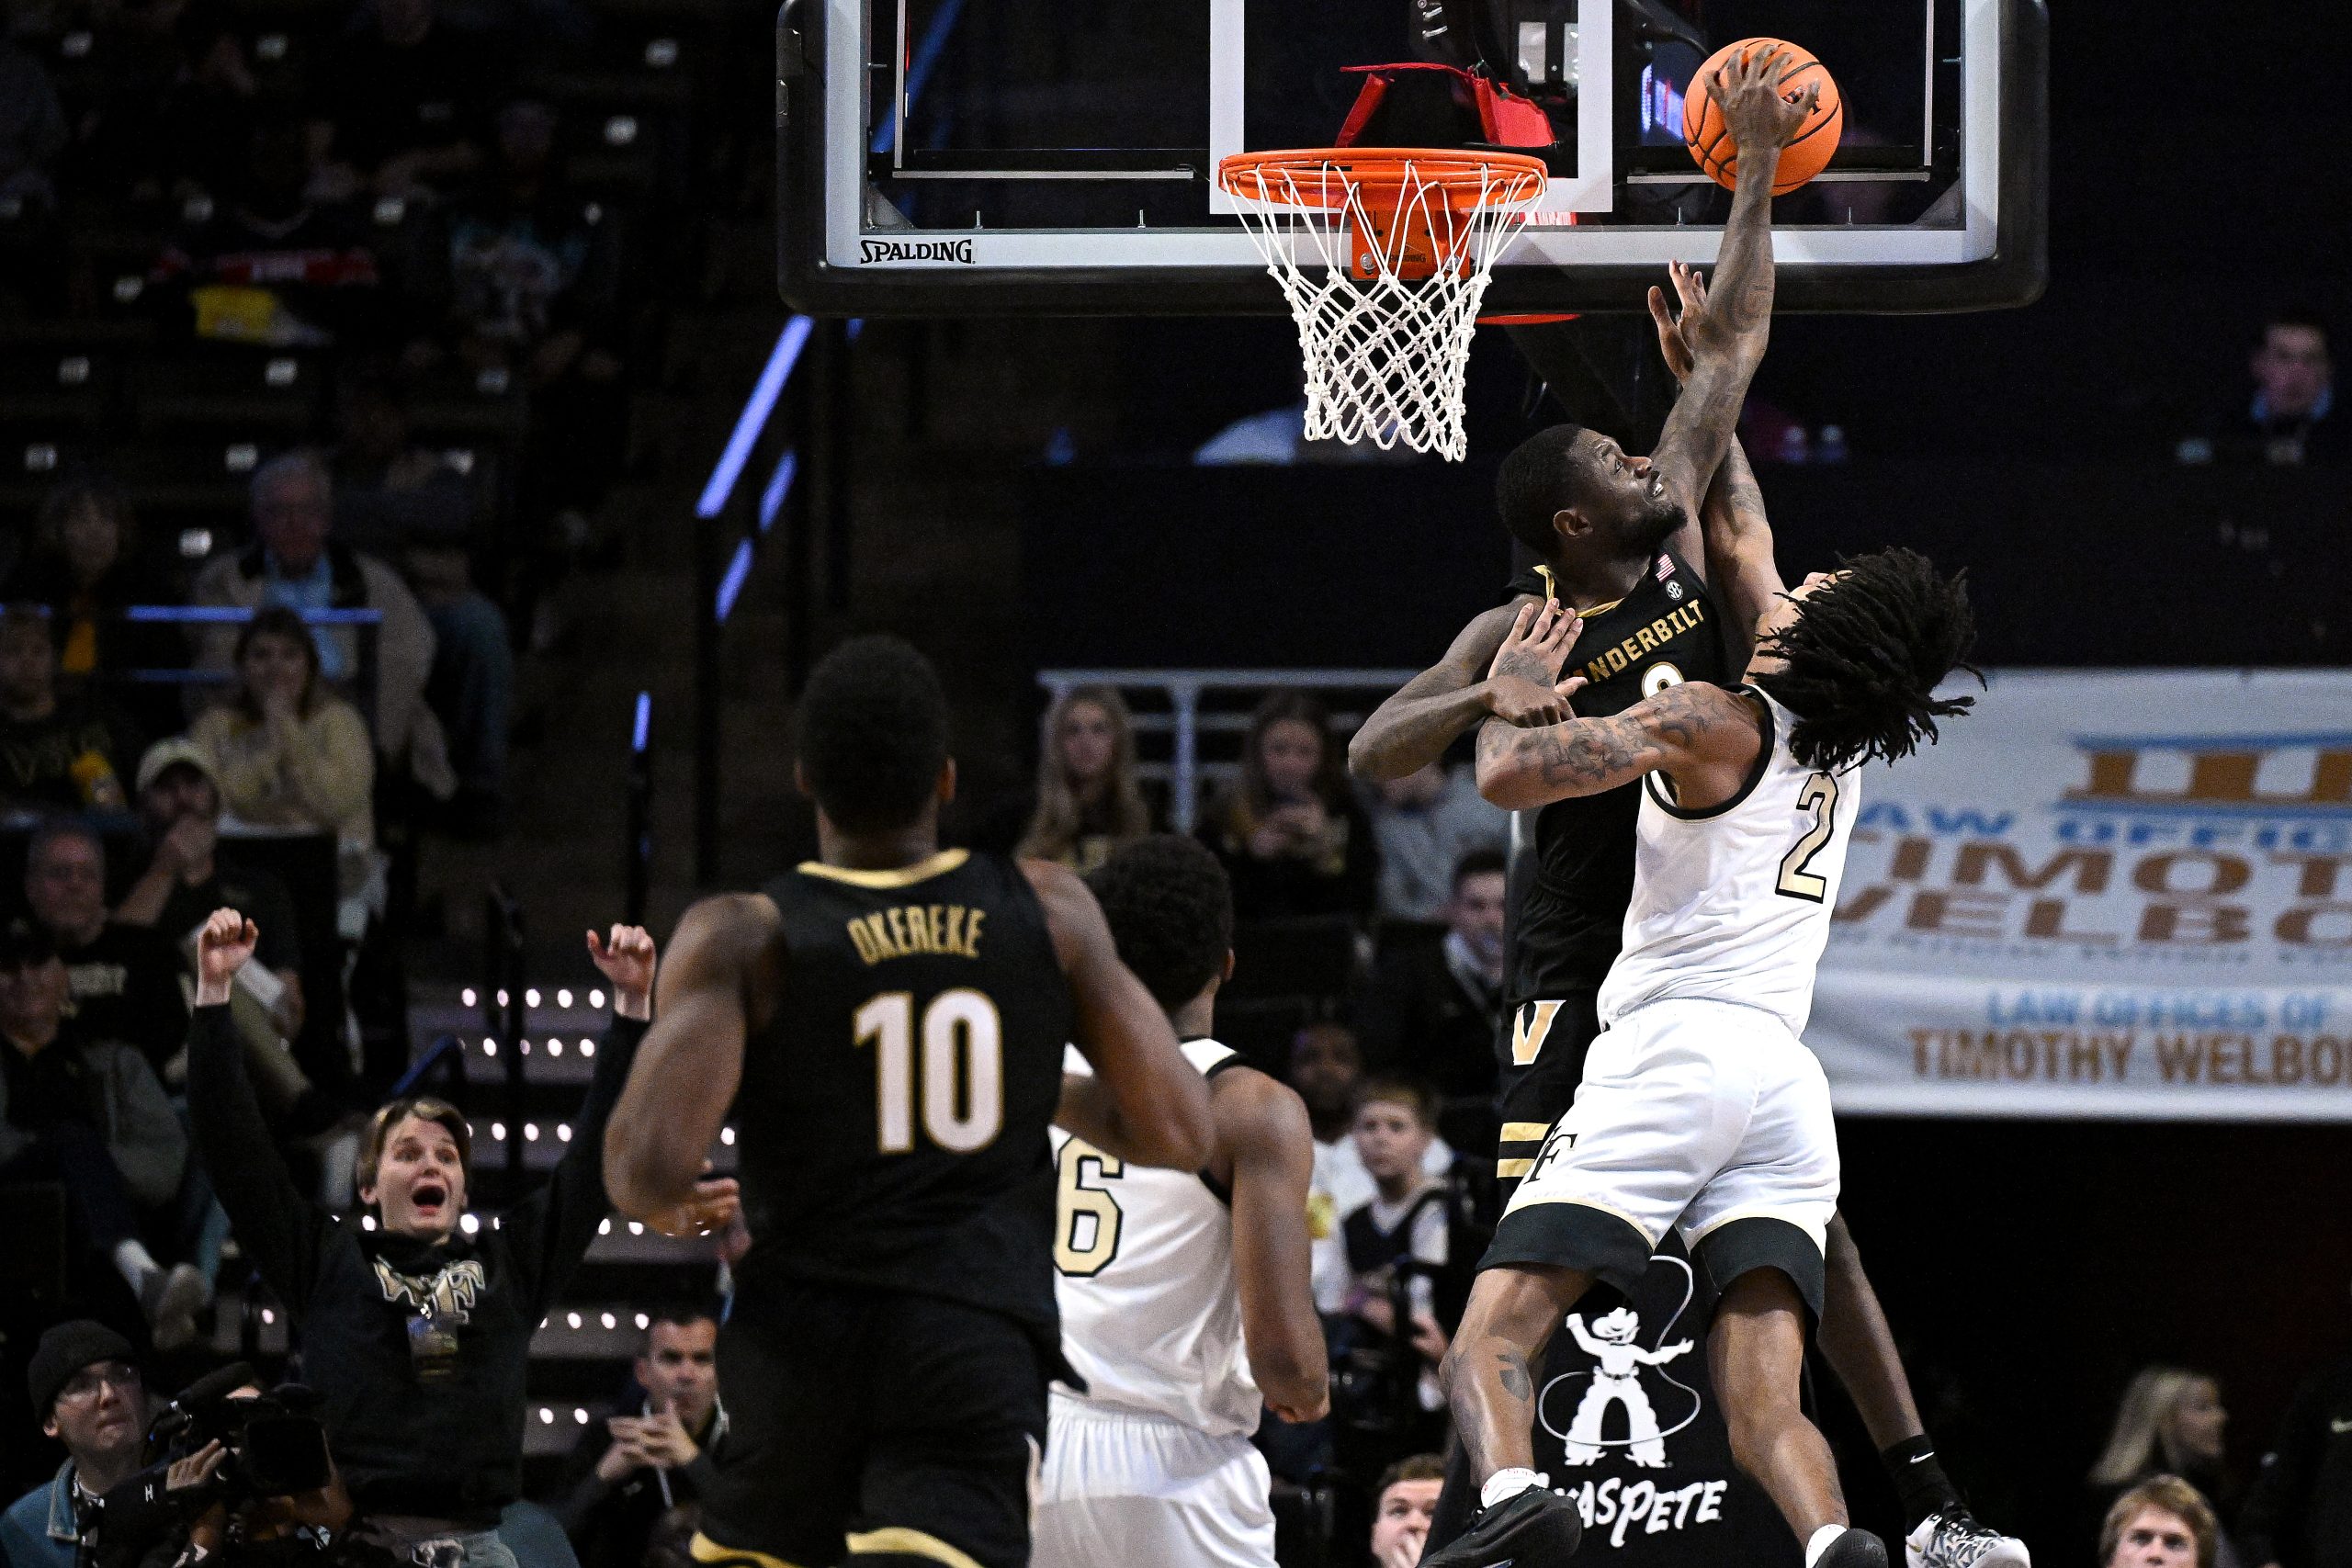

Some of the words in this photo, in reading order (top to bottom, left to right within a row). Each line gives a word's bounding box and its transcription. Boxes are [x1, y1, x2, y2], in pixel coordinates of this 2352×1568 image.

[860, 239, 972, 264] SPALDING
[1666, 580, 1684, 601] SEC
[1565, 599, 1705, 682] NDERBILT
[1775, 772, 1838, 904] 2
[1856, 800, 2014, 836] AW
[847, 904, 986, 965] OKEREKE
[1511, 999, 1567, 1066] V
[1907, 1027, 2136, 1083] TIMOTHY
[2153, 1032, 2351, 1086] WELBO
[853, 987, 1004, 1156] 10
[1054, 1137, 1123, 1277] 6
